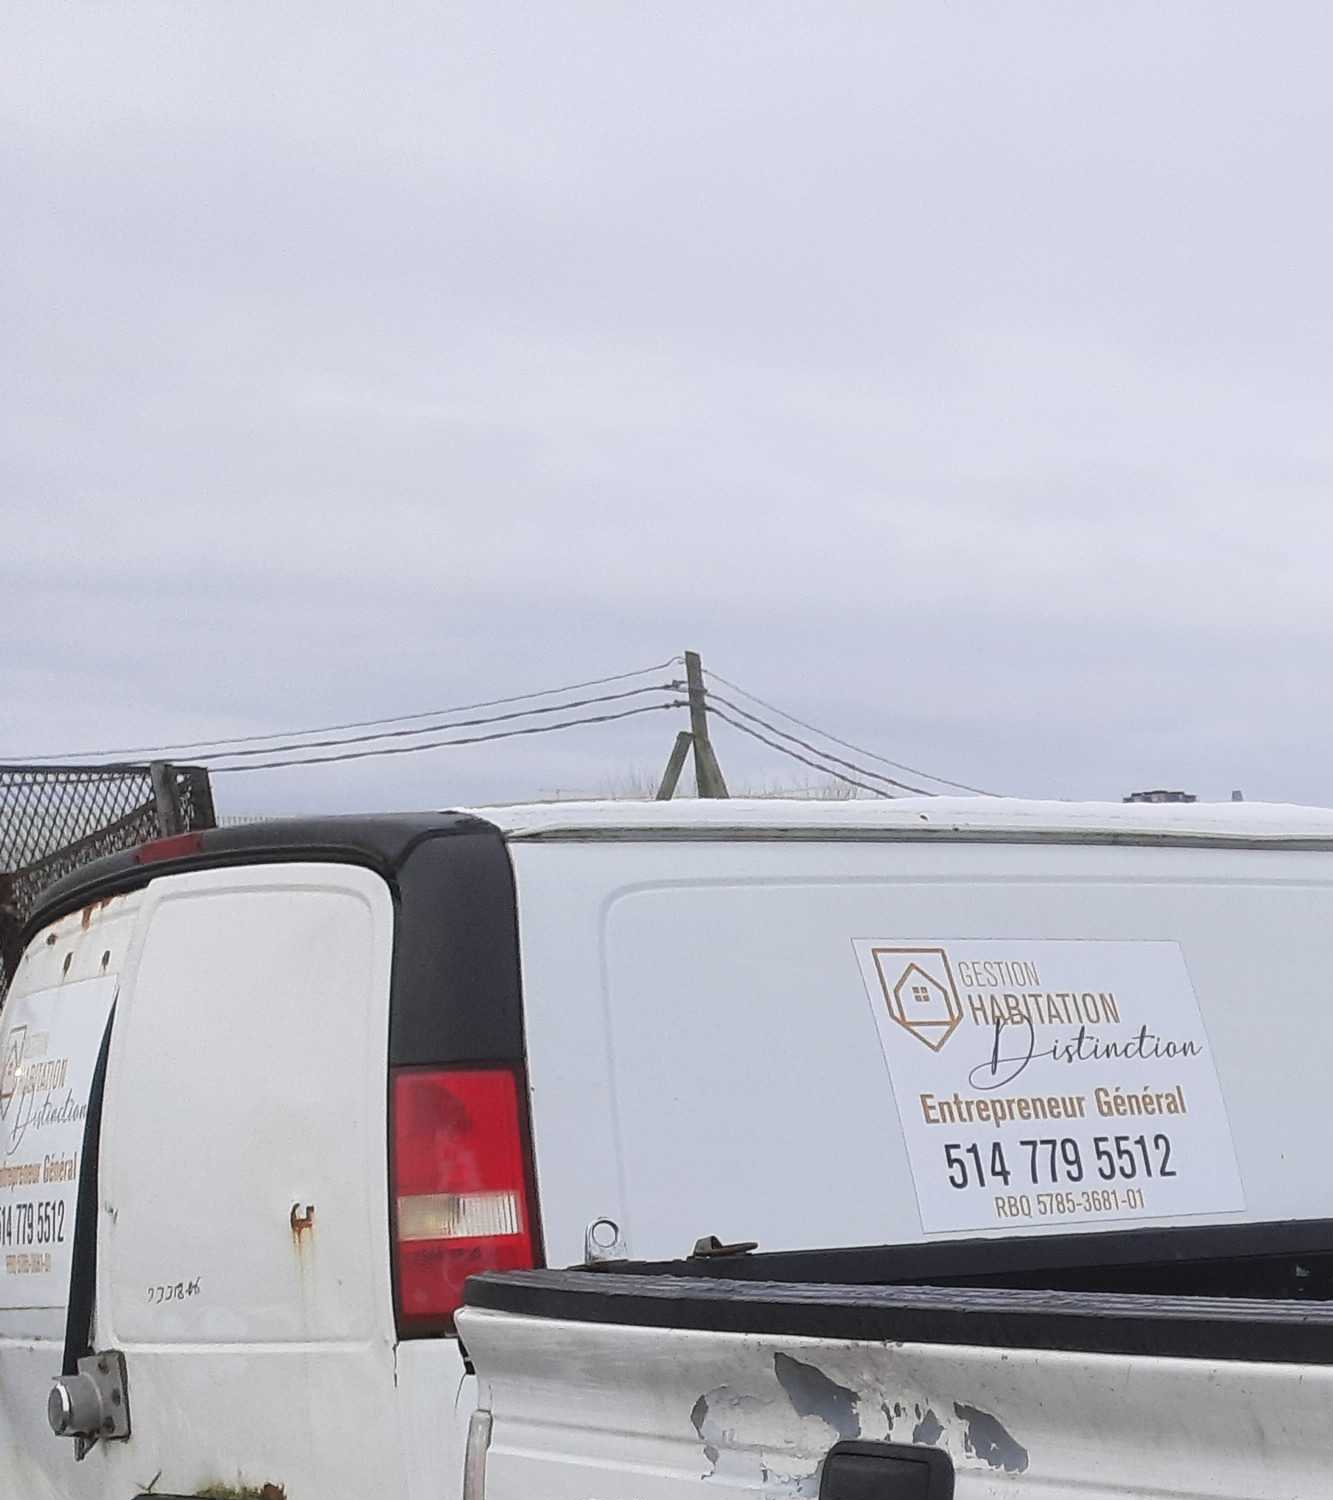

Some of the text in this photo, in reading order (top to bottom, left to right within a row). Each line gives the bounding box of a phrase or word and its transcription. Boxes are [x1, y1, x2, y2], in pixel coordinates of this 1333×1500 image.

[958, 961, 1041, 988] GESTION
[967, 992, 1121, 1027] HABITATION
[968, 1011, 1203, 1091] Distinction
[919, 1084, 1188, 1129] Entrepreneur Général
[944, 1133, 1177, 1191] 514 779 5512
[0, 1204, 12, 1247] 14
[37, 1199, 65, 1243] 5512
[994, 1187, 1145, 1219] RBQ 5785-3681-01
